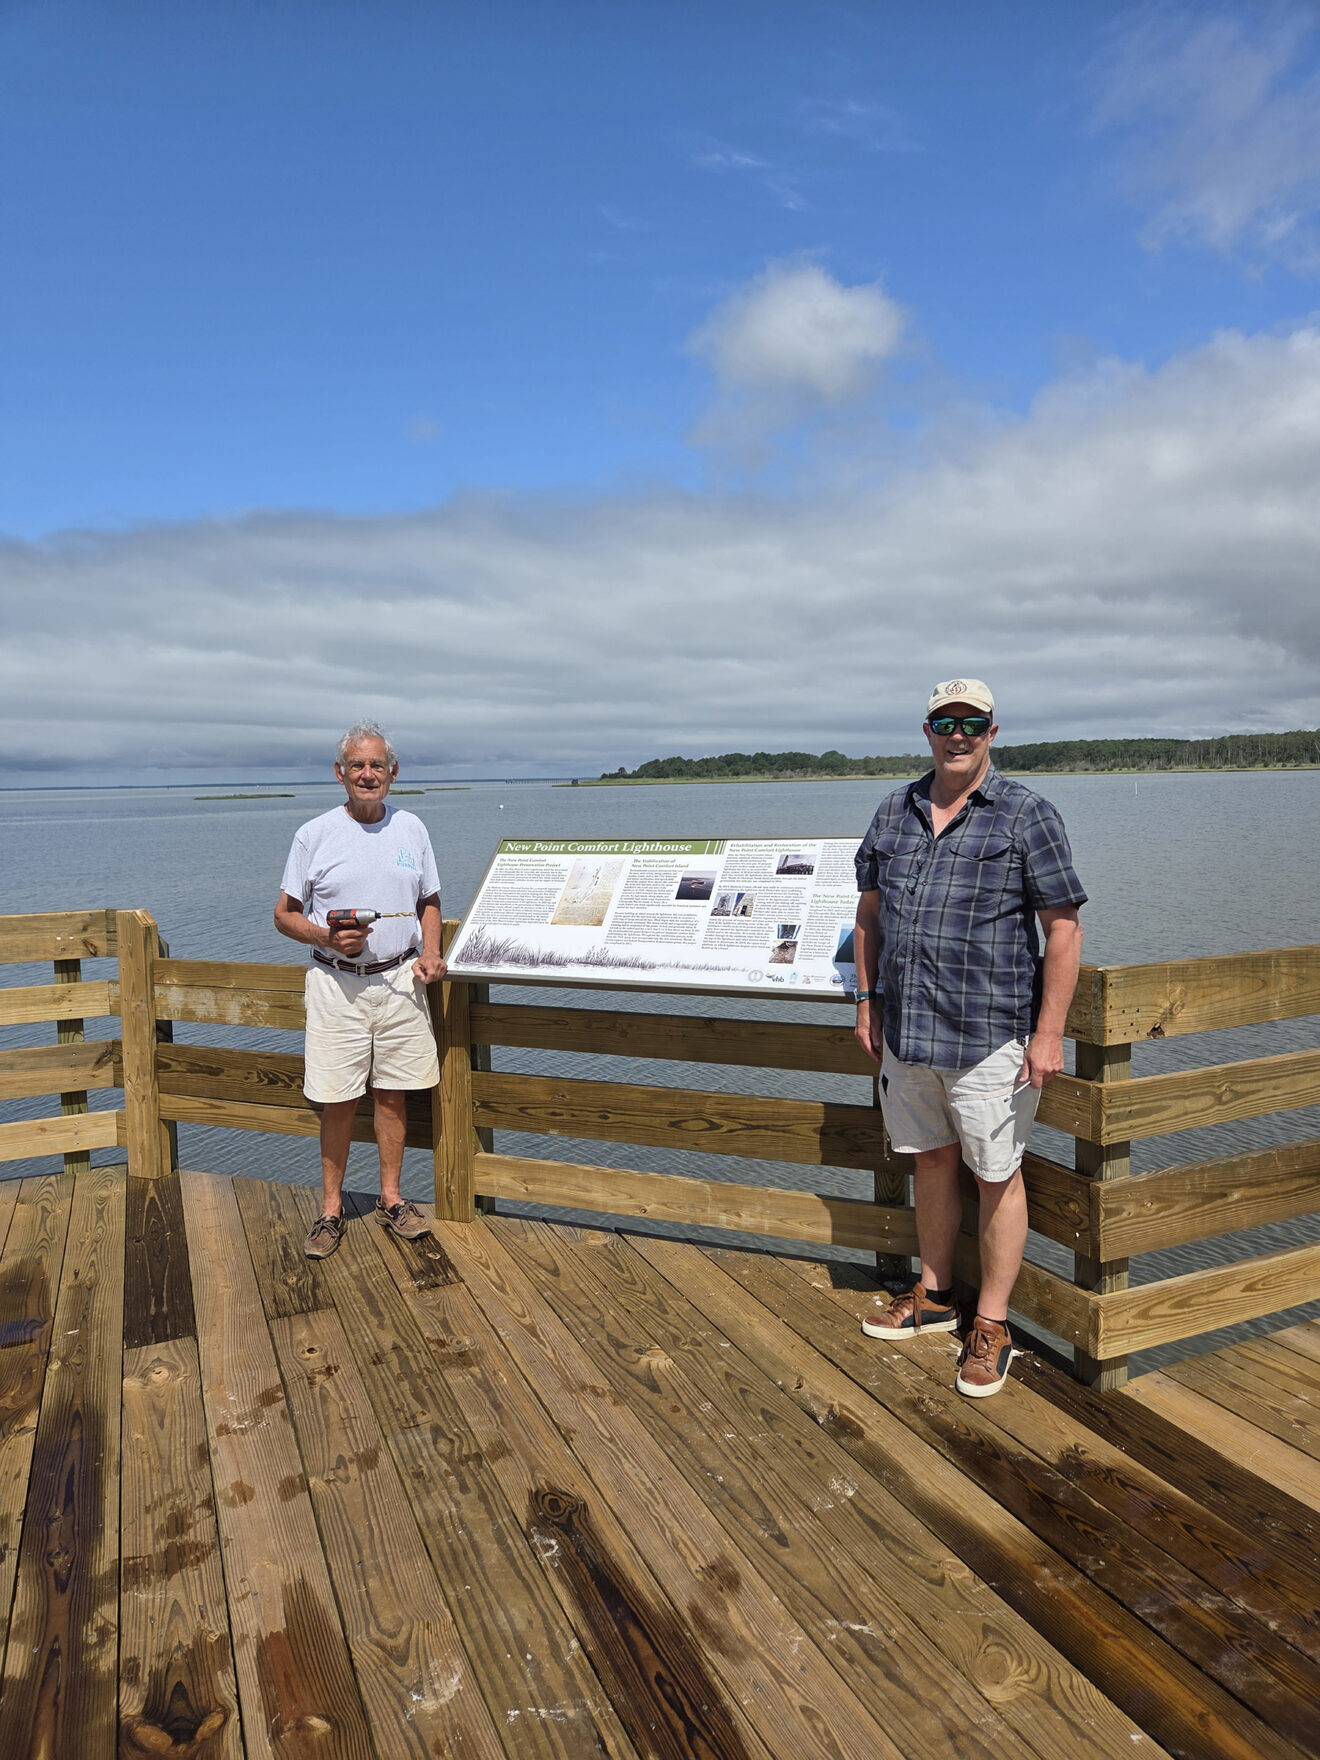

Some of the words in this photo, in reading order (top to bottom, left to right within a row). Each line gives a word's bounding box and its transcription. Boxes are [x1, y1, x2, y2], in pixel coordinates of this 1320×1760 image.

[504, 843, 530, 852] New
[532, 843, 566, 852] Point
[568, 842, 619, 852] Comfort
[622, 842, 692, 854] Lighthouse
